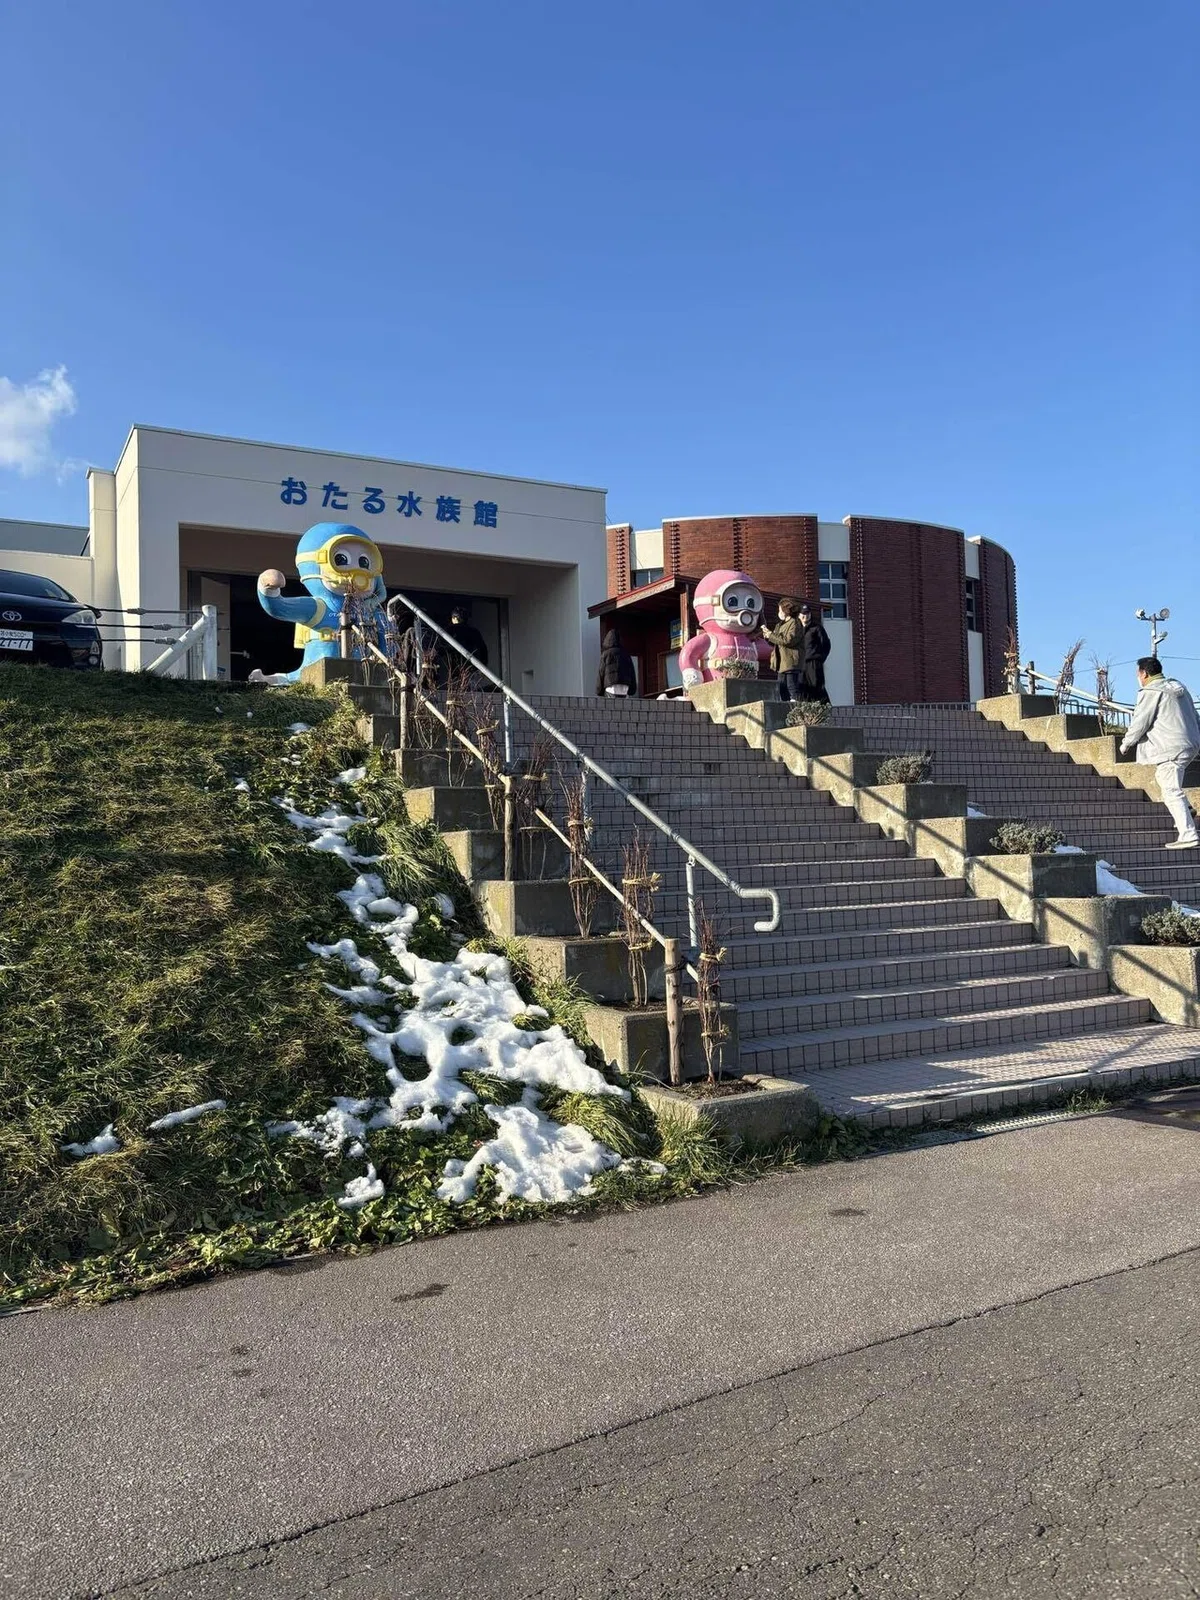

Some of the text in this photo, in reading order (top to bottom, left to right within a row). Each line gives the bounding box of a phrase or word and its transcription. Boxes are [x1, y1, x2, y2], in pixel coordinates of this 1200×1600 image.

[280, 477, 499, 528] おたる水族館
